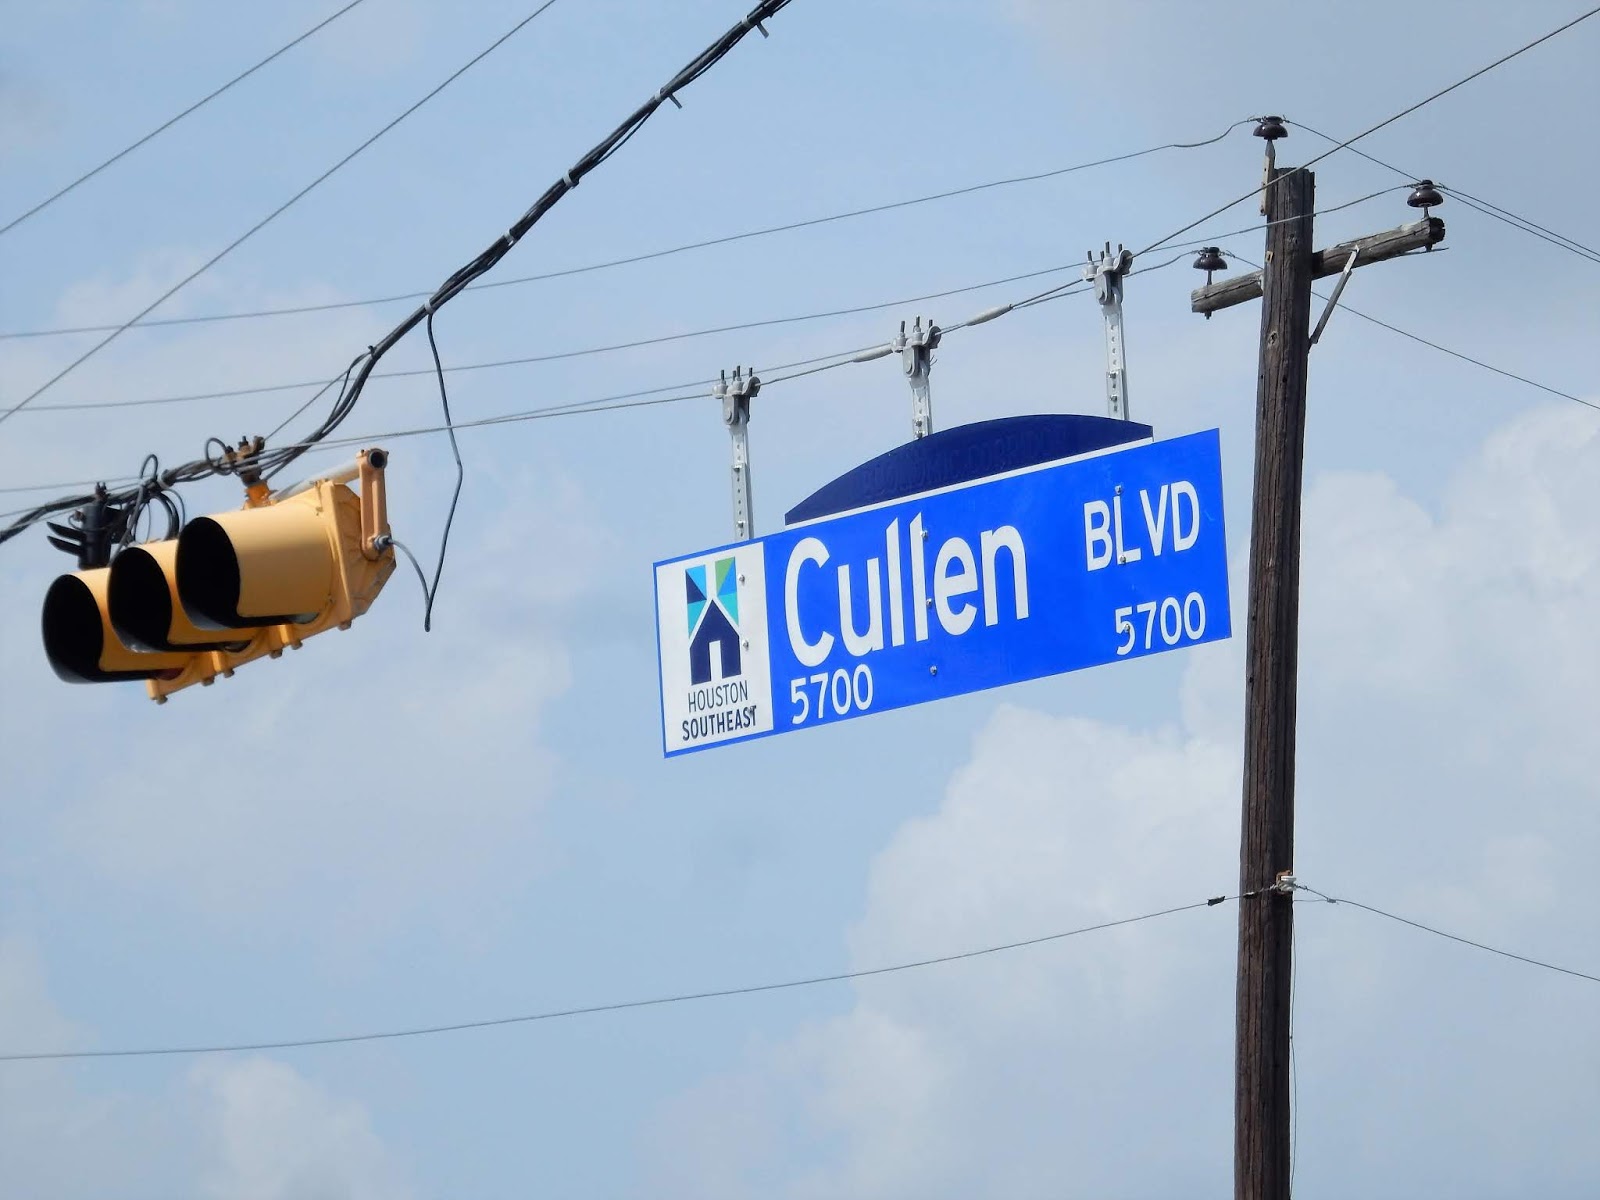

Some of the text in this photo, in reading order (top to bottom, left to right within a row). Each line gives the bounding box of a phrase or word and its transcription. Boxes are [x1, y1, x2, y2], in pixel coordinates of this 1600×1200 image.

[785, 480, 1200, 667] Cullen BLVD
[1115, 591, 1206, 656] 5700
[682, 705, 757, 741] SOUTHEAST
[687, 680, 748, 714] HOUSTON
[790, 664, 873, 725] 5700
